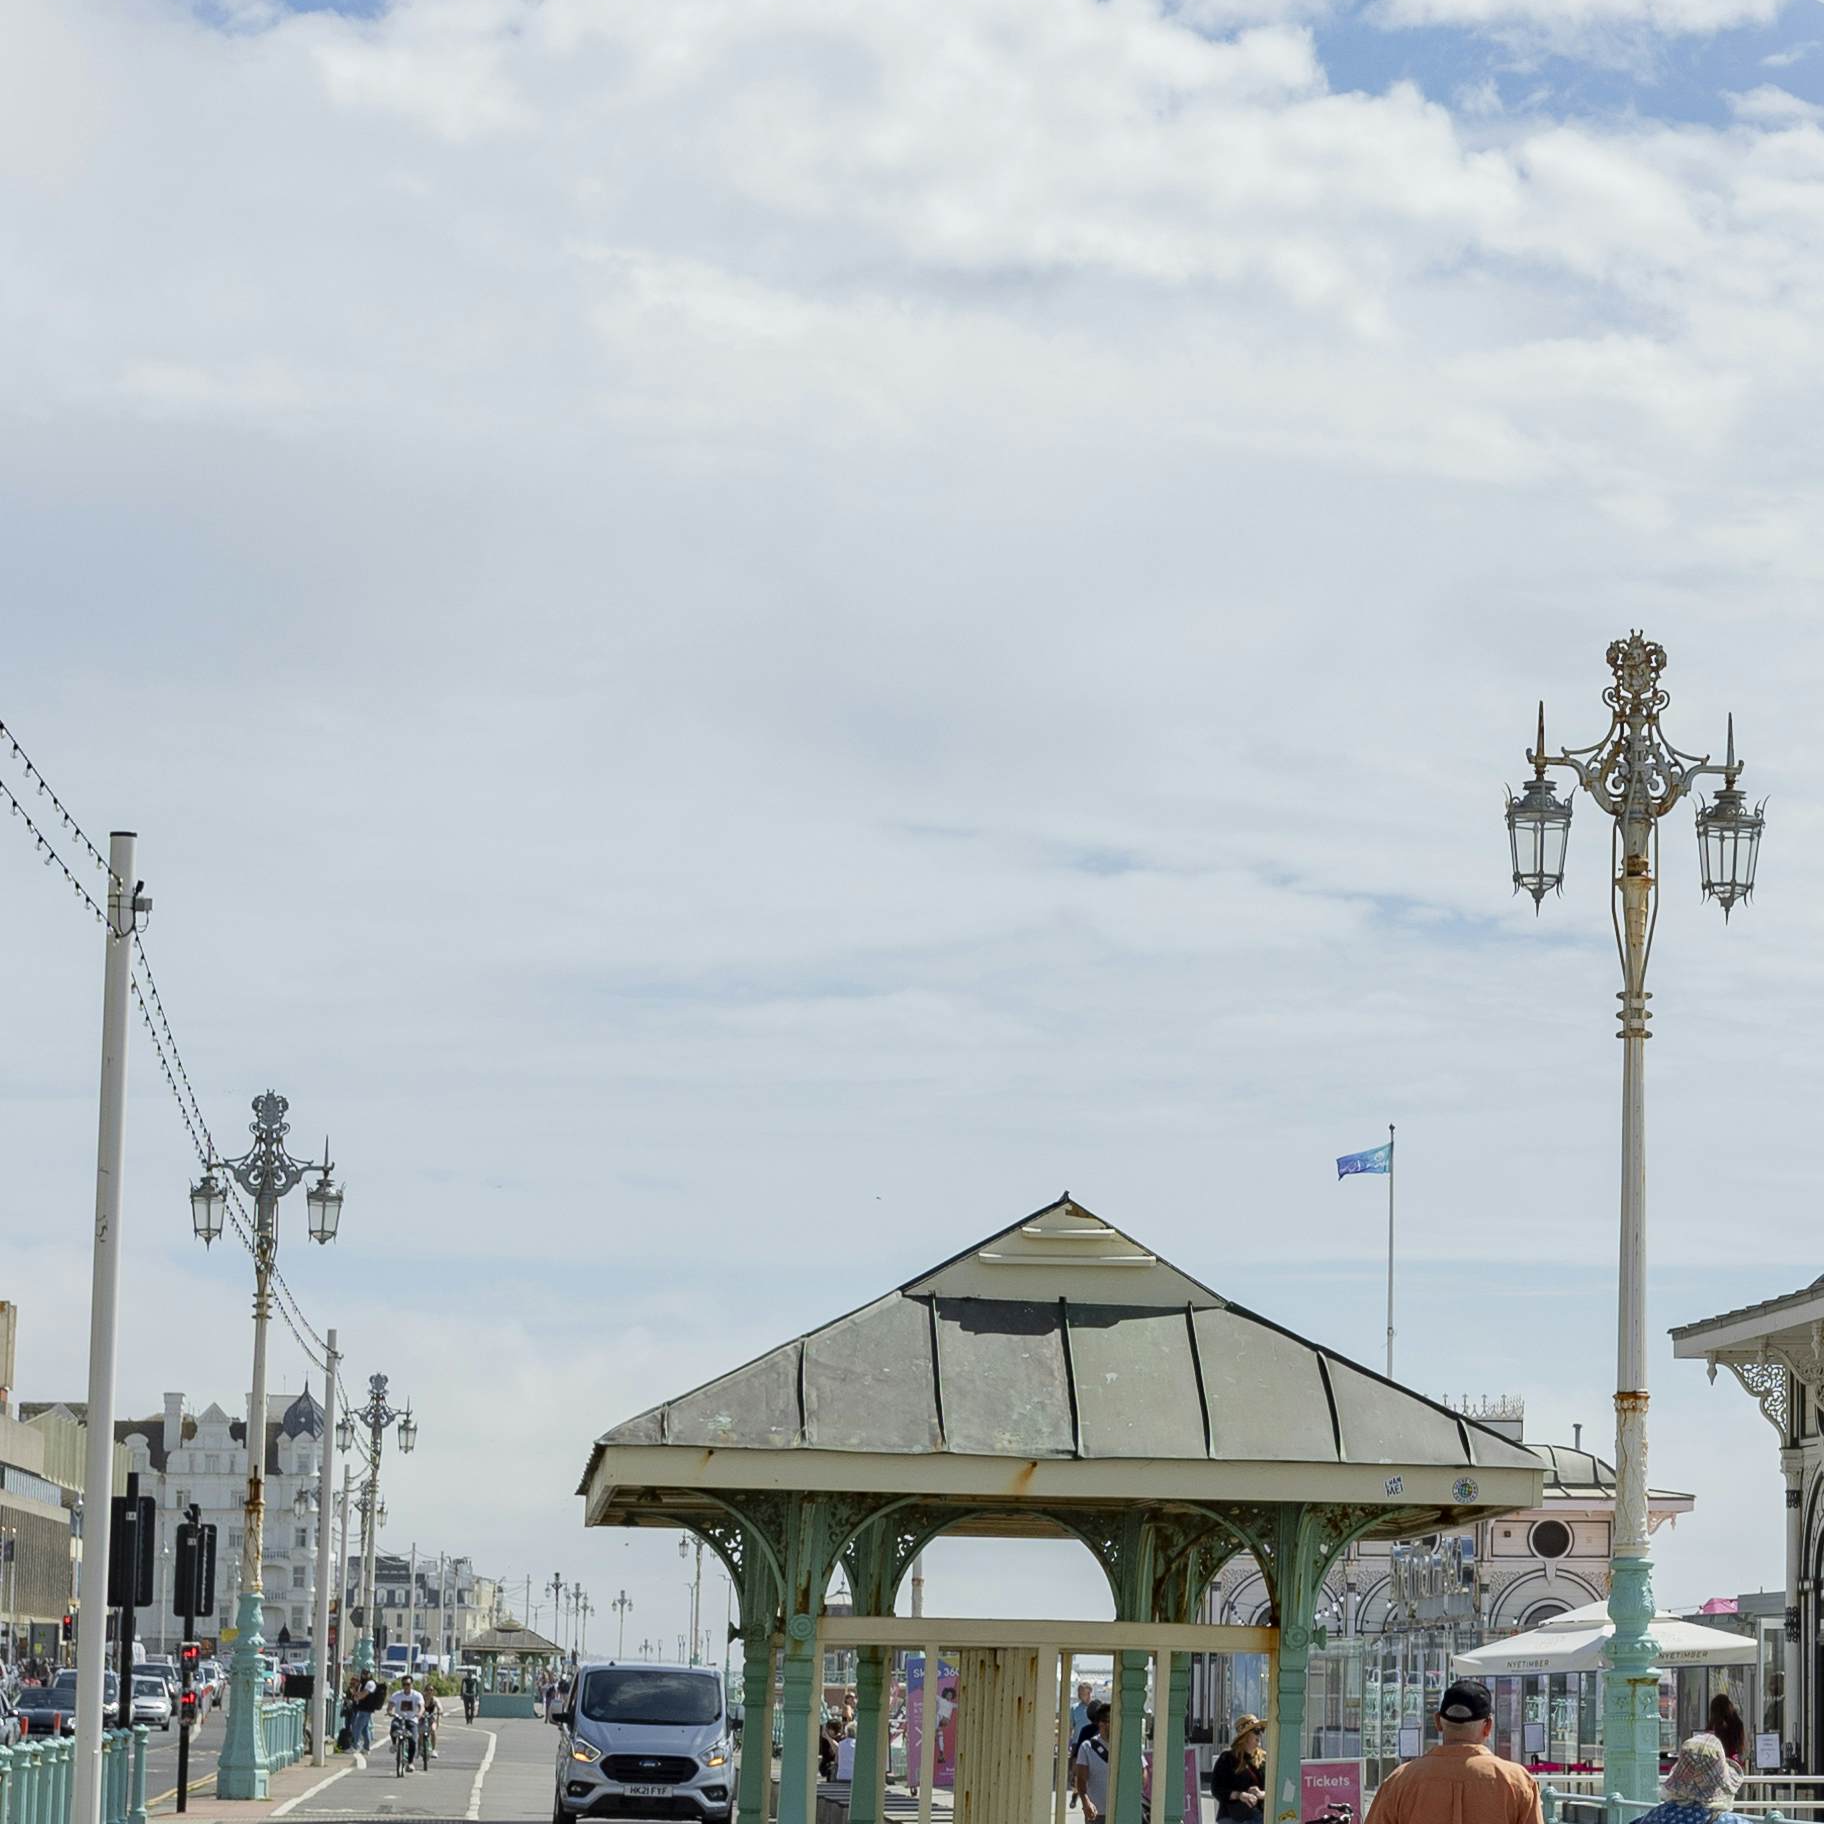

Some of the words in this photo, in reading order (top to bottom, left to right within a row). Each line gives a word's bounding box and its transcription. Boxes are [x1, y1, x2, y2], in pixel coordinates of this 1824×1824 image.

[1506, 1659, 1550, 1668] NYETIMBER
[1304, 1775, 1350, 1788] Tickets
[630, 1786, 649, 1795] HK21
